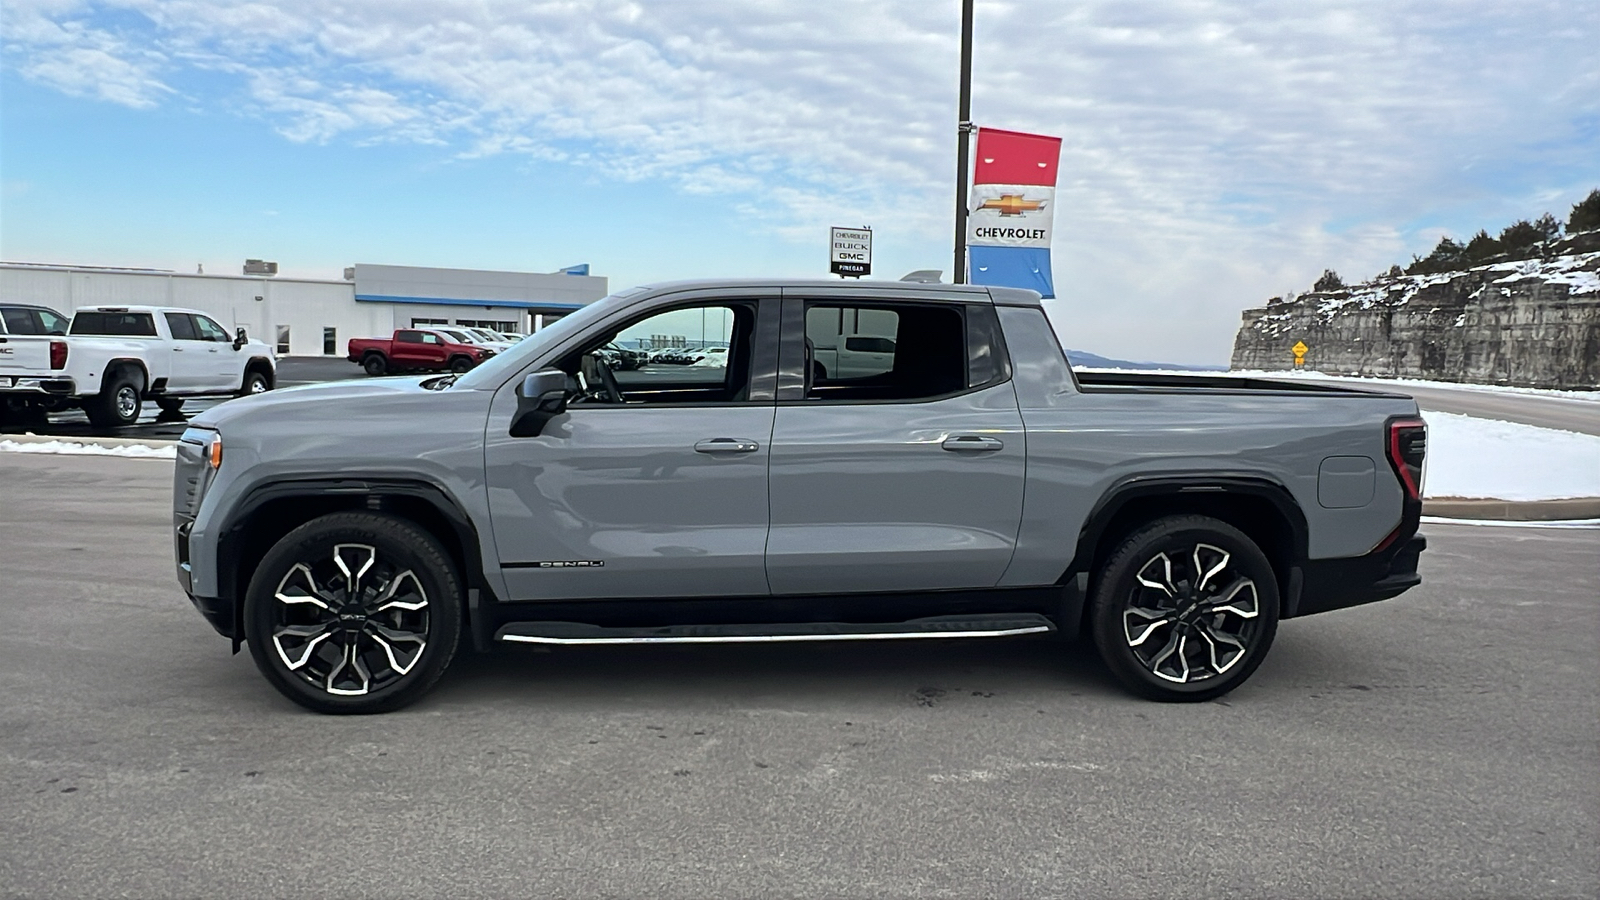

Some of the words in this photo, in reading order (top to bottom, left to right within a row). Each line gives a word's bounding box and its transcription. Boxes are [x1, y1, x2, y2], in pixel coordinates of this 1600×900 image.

[836, 232, 869, 240] CHEVROLET
[975, 227, 1046, 239] CHEVROLET
[834, 242, 868, 250] BUICK
[839, 252, 864, 260] GMC
